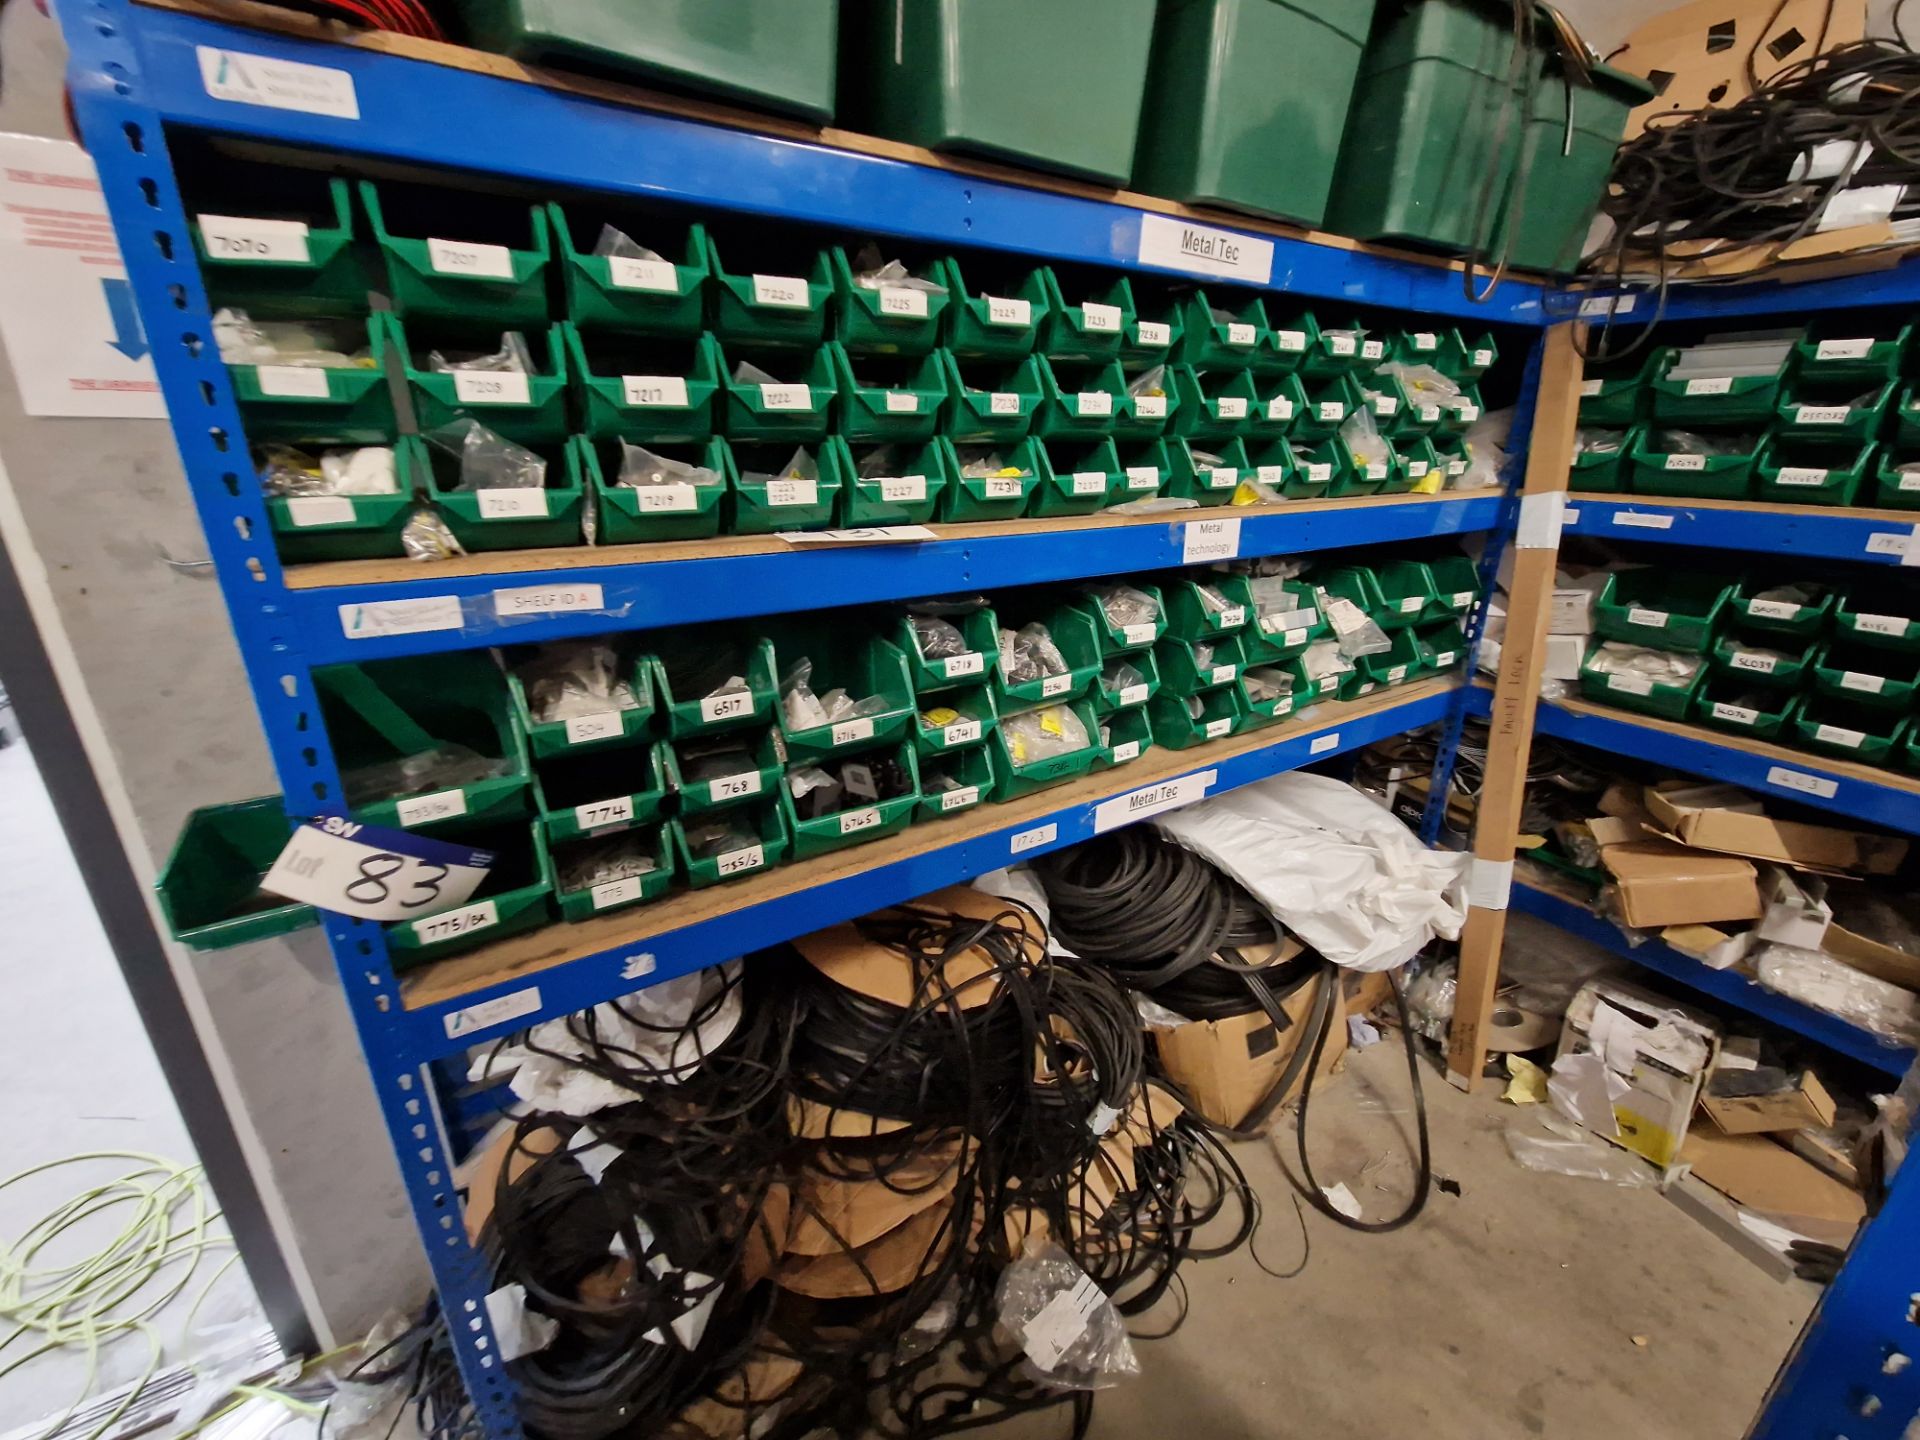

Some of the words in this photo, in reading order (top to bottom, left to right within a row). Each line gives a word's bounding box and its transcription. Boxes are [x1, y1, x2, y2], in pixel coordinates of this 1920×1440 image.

[214, 236, 272, 255] 7070
[1181, 229, 1217, 256] Metal
[1220, 238, 1240, 261] Tec
[631, 388, 664, 403] 7217
[1199, 522, 1224, 535] Metal
[1186, 543, 1232, 557] technology
[514, 594, 556, 608] SHELF
[561, 593, 575, 605] ID
[578, 592, 589, 603] A
[713, 700, 742, 716] 6517
[948, 729, 972, 743] 6741
[721, 779, 750, 796] 768
[1129, 790, 1158, 809] Metal
[1161, 786, 1179, 800] Tec
[586, 805, 628, 822] 774
[845, 816, 874, 832] 6745
[284, 849, 326, 879] Lot
[346, 853, 449, 908] 83
